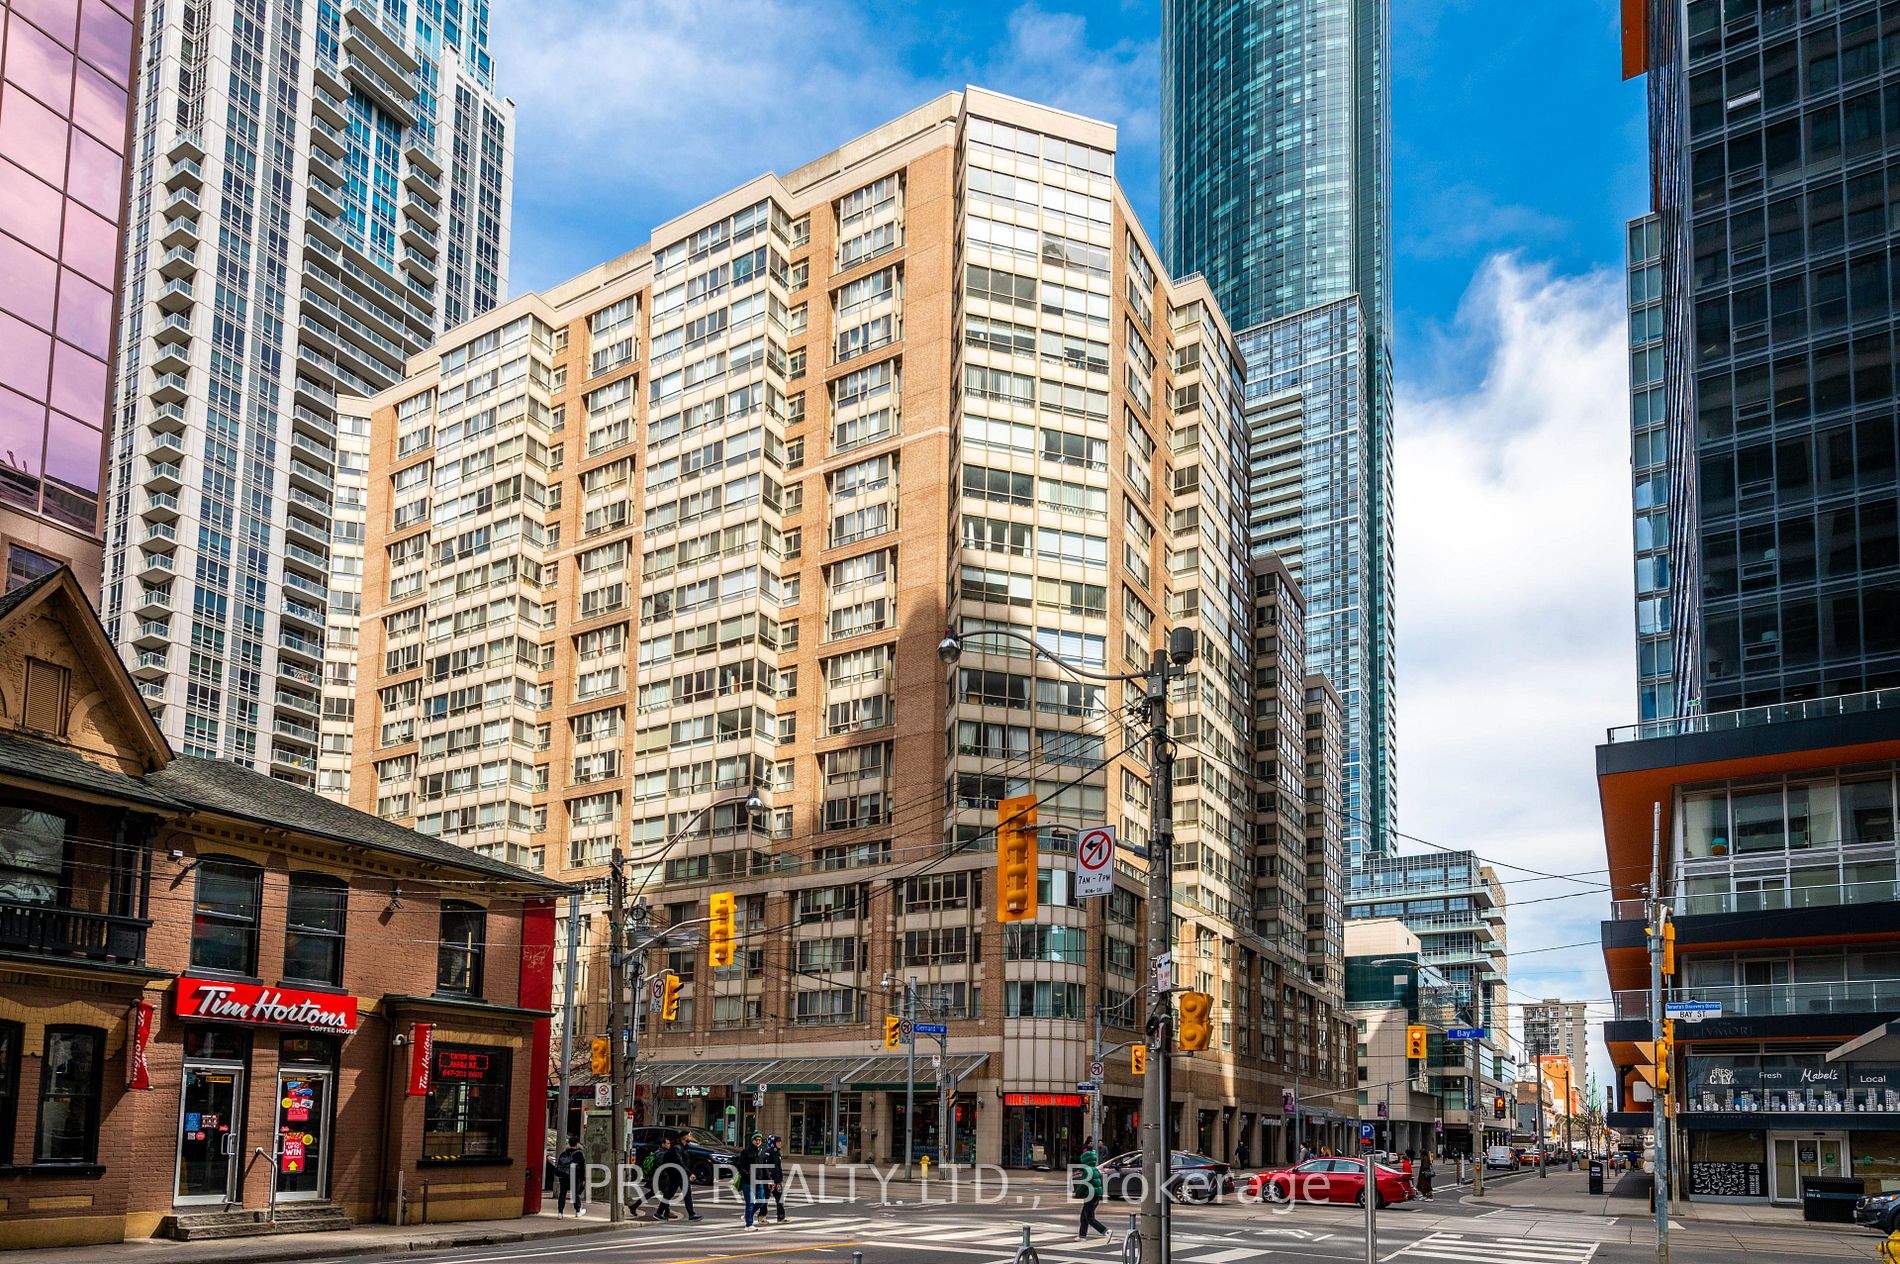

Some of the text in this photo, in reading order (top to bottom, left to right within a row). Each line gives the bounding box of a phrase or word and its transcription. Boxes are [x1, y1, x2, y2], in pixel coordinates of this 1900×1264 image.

[199, 985, 346, 1028] Tim Hortons
[310, 1025, 358, 1036] COFFEE HOUSE
[1456, 1030, 1471, 1038] Bay
[1711, 1068, 1734, 1077] FRESH
[1759, 1071, 1783, 1079] Fresh
[1801, 1068, 1839, 1083] Mabel's
[1860, 1074, 1887, 1083] Local
[1362, 1125, 1371, 1136] P
[285, 1148, 302, 1156] WIN
